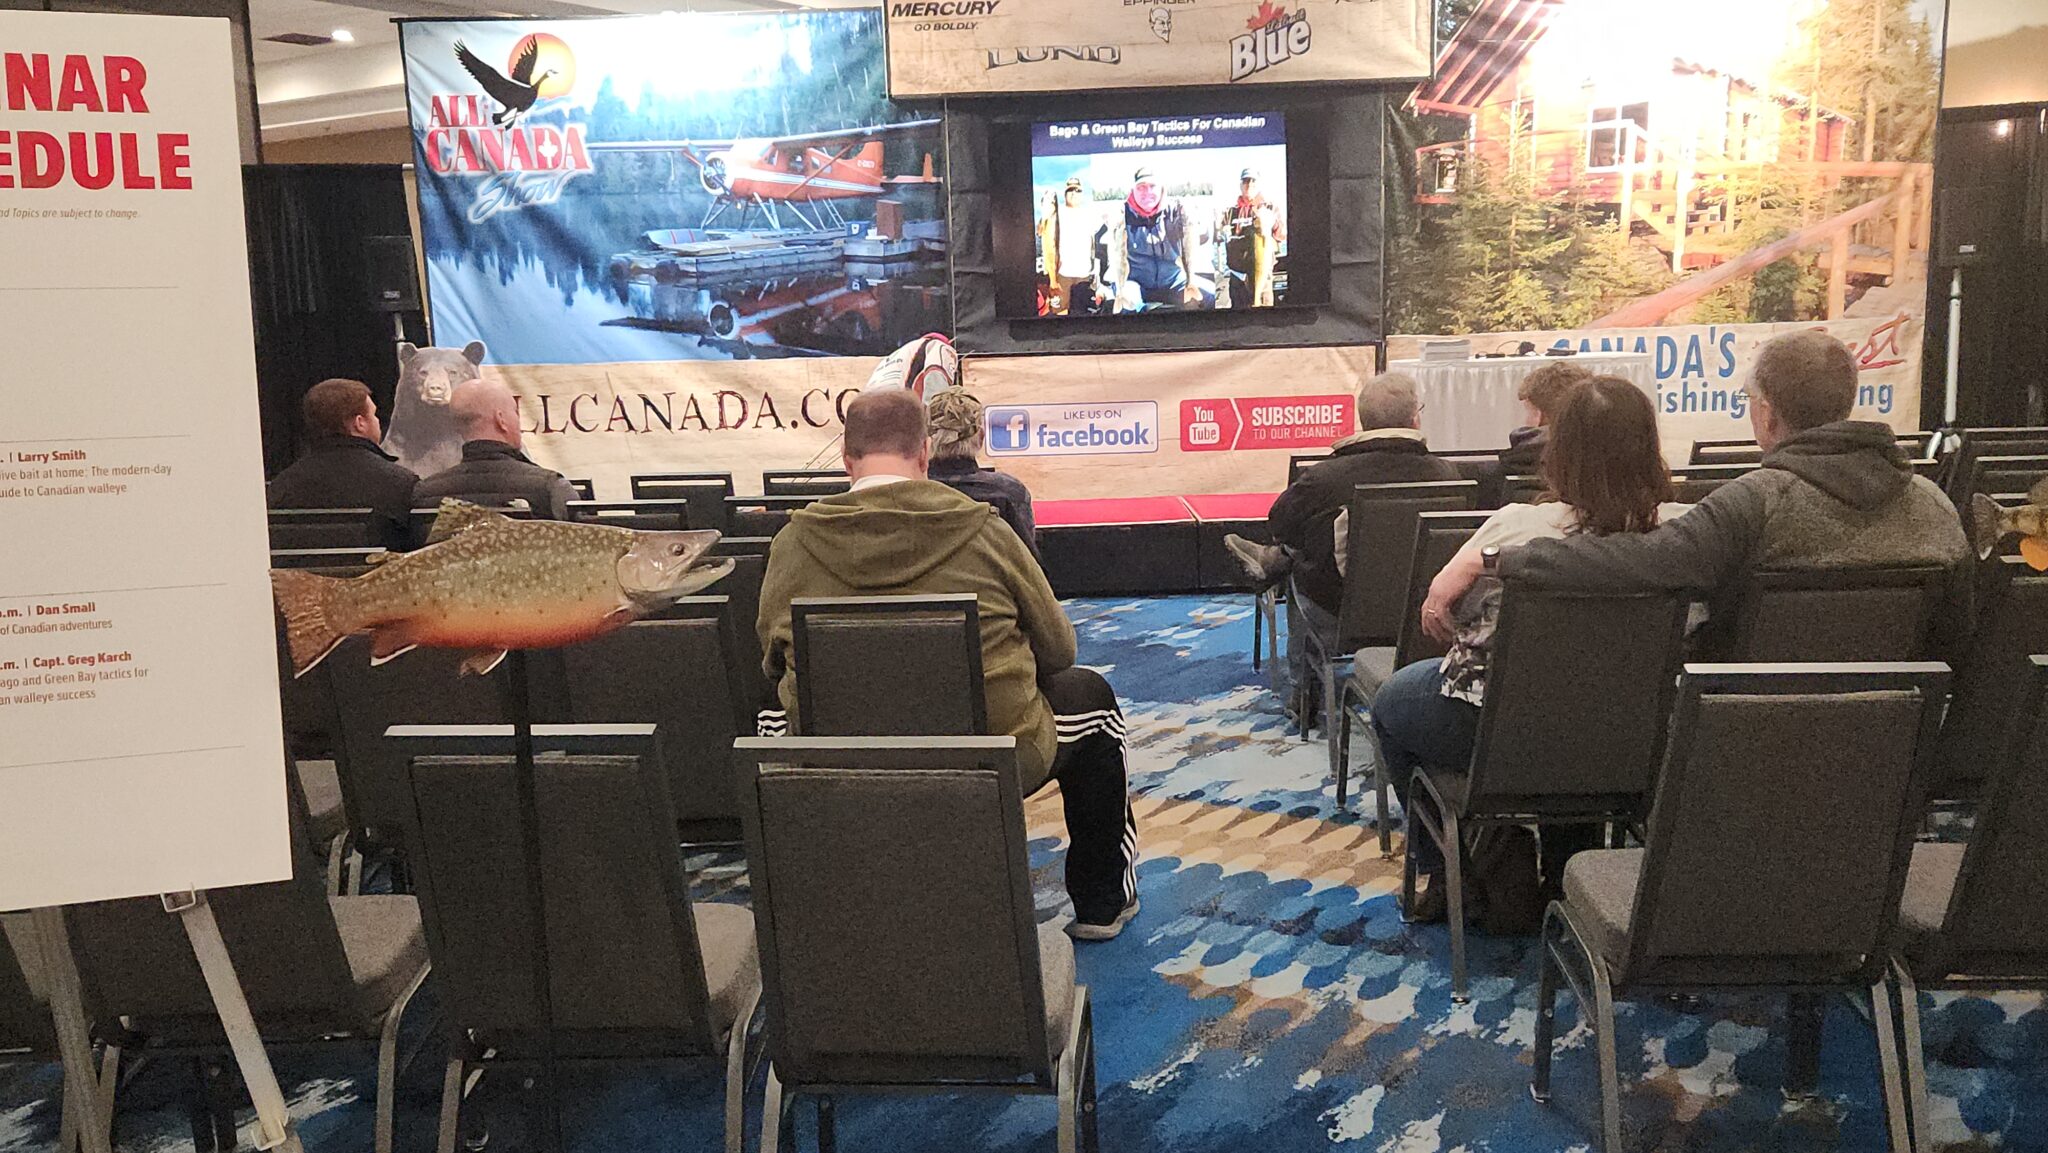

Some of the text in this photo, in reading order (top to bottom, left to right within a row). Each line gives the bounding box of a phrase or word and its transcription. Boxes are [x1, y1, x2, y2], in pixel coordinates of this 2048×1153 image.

[891, 1, 1000, 17] MERCURY
[914, 24, 931, 32] GO
[985, 45, 1121, 70] LUND
[1229, 20, 1311, 82] Blue
[5, 53, 150, 114] NAR
[429, 95, 488, 127] ALL
[1049, 116, 1266, 138] Bago & Green Bay Tactics For Canadian
[427, 126, 591, 173] CANADA
[1112, 134, 1203, 149] Walleye Success
[472, 171, 577, 221] Show
[12, 208, 40, 220] Topics
[42, 209, 57, 218] are
[60, 208, 92, 220] subject
[94, 209, 103, 218] to
[1064, 410, 1121, 420] LIKE US ON
[1194, 406, 1213, 422] You
[1252, 404, 1343, 426] SUBSCRIBE
[1037, 422, 1149, 447] facebook
[1192, 427, 1217, 441] Tube
[1253, 426, 1343, 440] TO OUR CHANNEL
[18, 450, 86, 464] Larry Smith
[20, 468, 40, 480] bait
[43, 469, 52, 479] at
[91, 466, 108, 477] The
[111, 464, 172, 477] modern-day
[24, 486, 34, 497] to
[37, 484, 85, 497] Canadian
[88, 483, 127, 496] walleye
[36, 605, 60, 615] Dan
[62, 602, 96, 614] Small
[0, 619, 112, 636] of Canadian adventures
[33, 656, 65, 669] Capt.
[67, 655, 95, 666] Greg
[97, 651, 132, 663] Karch
[22, 676, 42, 686] and
[44, 674, 75, 685] Green
[78, 671, 97, 683] Bay
[99, 668, 132, 680] tactics
[134, 667, 149, 678] for
[14, 692, 54, 704] walleye
[57, 689, 96, 701] success
